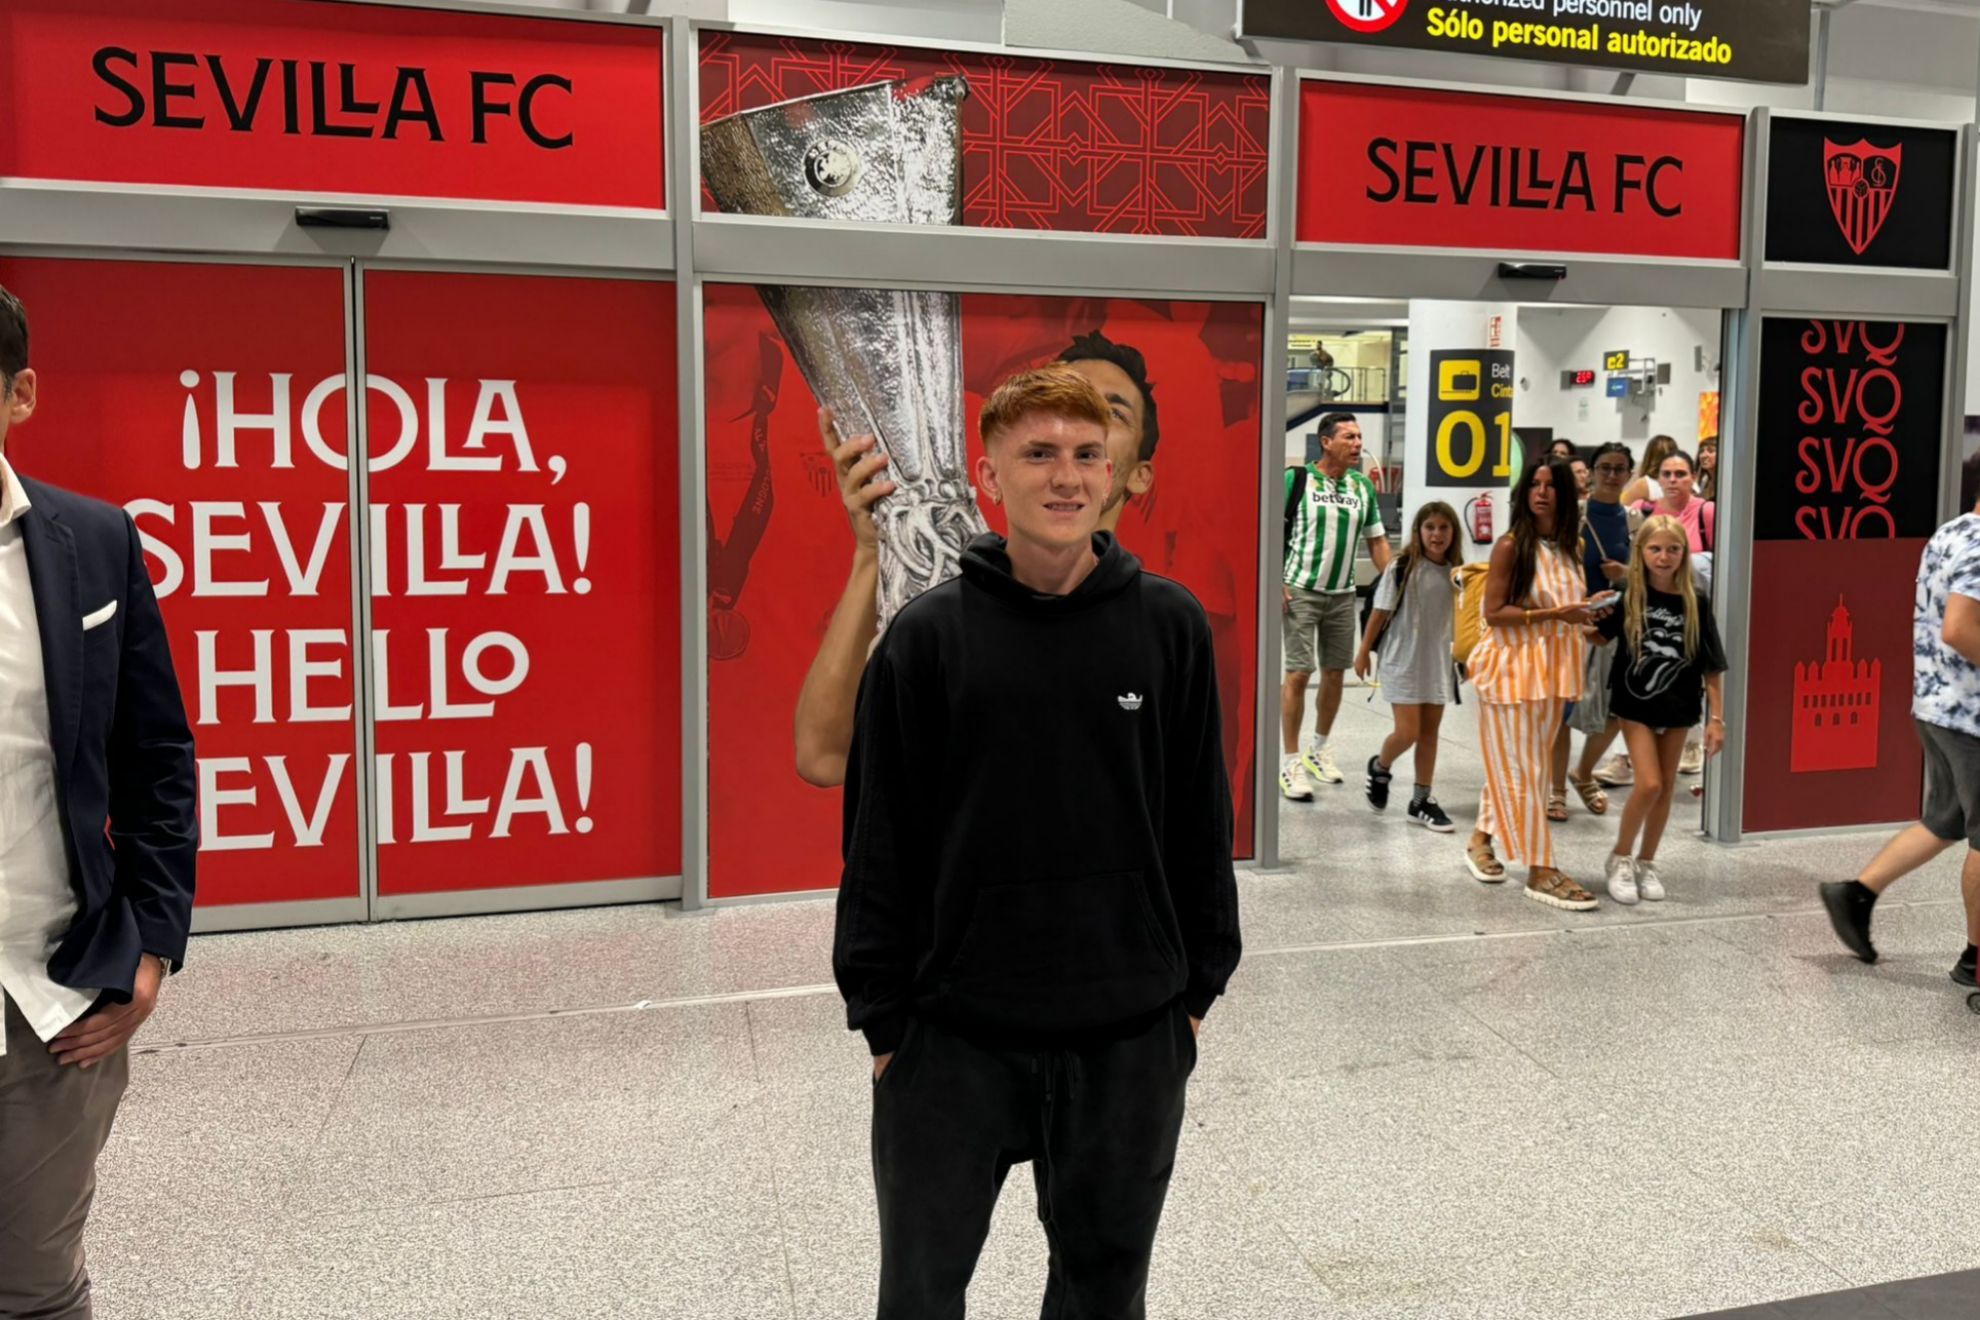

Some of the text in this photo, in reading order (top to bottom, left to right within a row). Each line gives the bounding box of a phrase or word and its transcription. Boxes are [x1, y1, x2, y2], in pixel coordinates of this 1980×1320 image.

[1426, 7, 1732, 65] Sólo personal autorizado
[1552, 0, 1702, 32] personnel only
[91, 46, 573, 150] SEVILLA FC
[1366, 137, 1683, 218] SEVILLA FC
[1491, 362, 1511, 379] Belt
[1798, 366, 1902, 436] SVQ
[180, 370, 567, 486] ¡HOLA,
[1435, 409, 1511, 478] 01
[1795, 437, 1899, 504] SVQ
[122, 498, 592, 600] SEVILLA!
[194, 627, 530, 725] HELLO
[194, 742, 594, 852] EVILLA!
